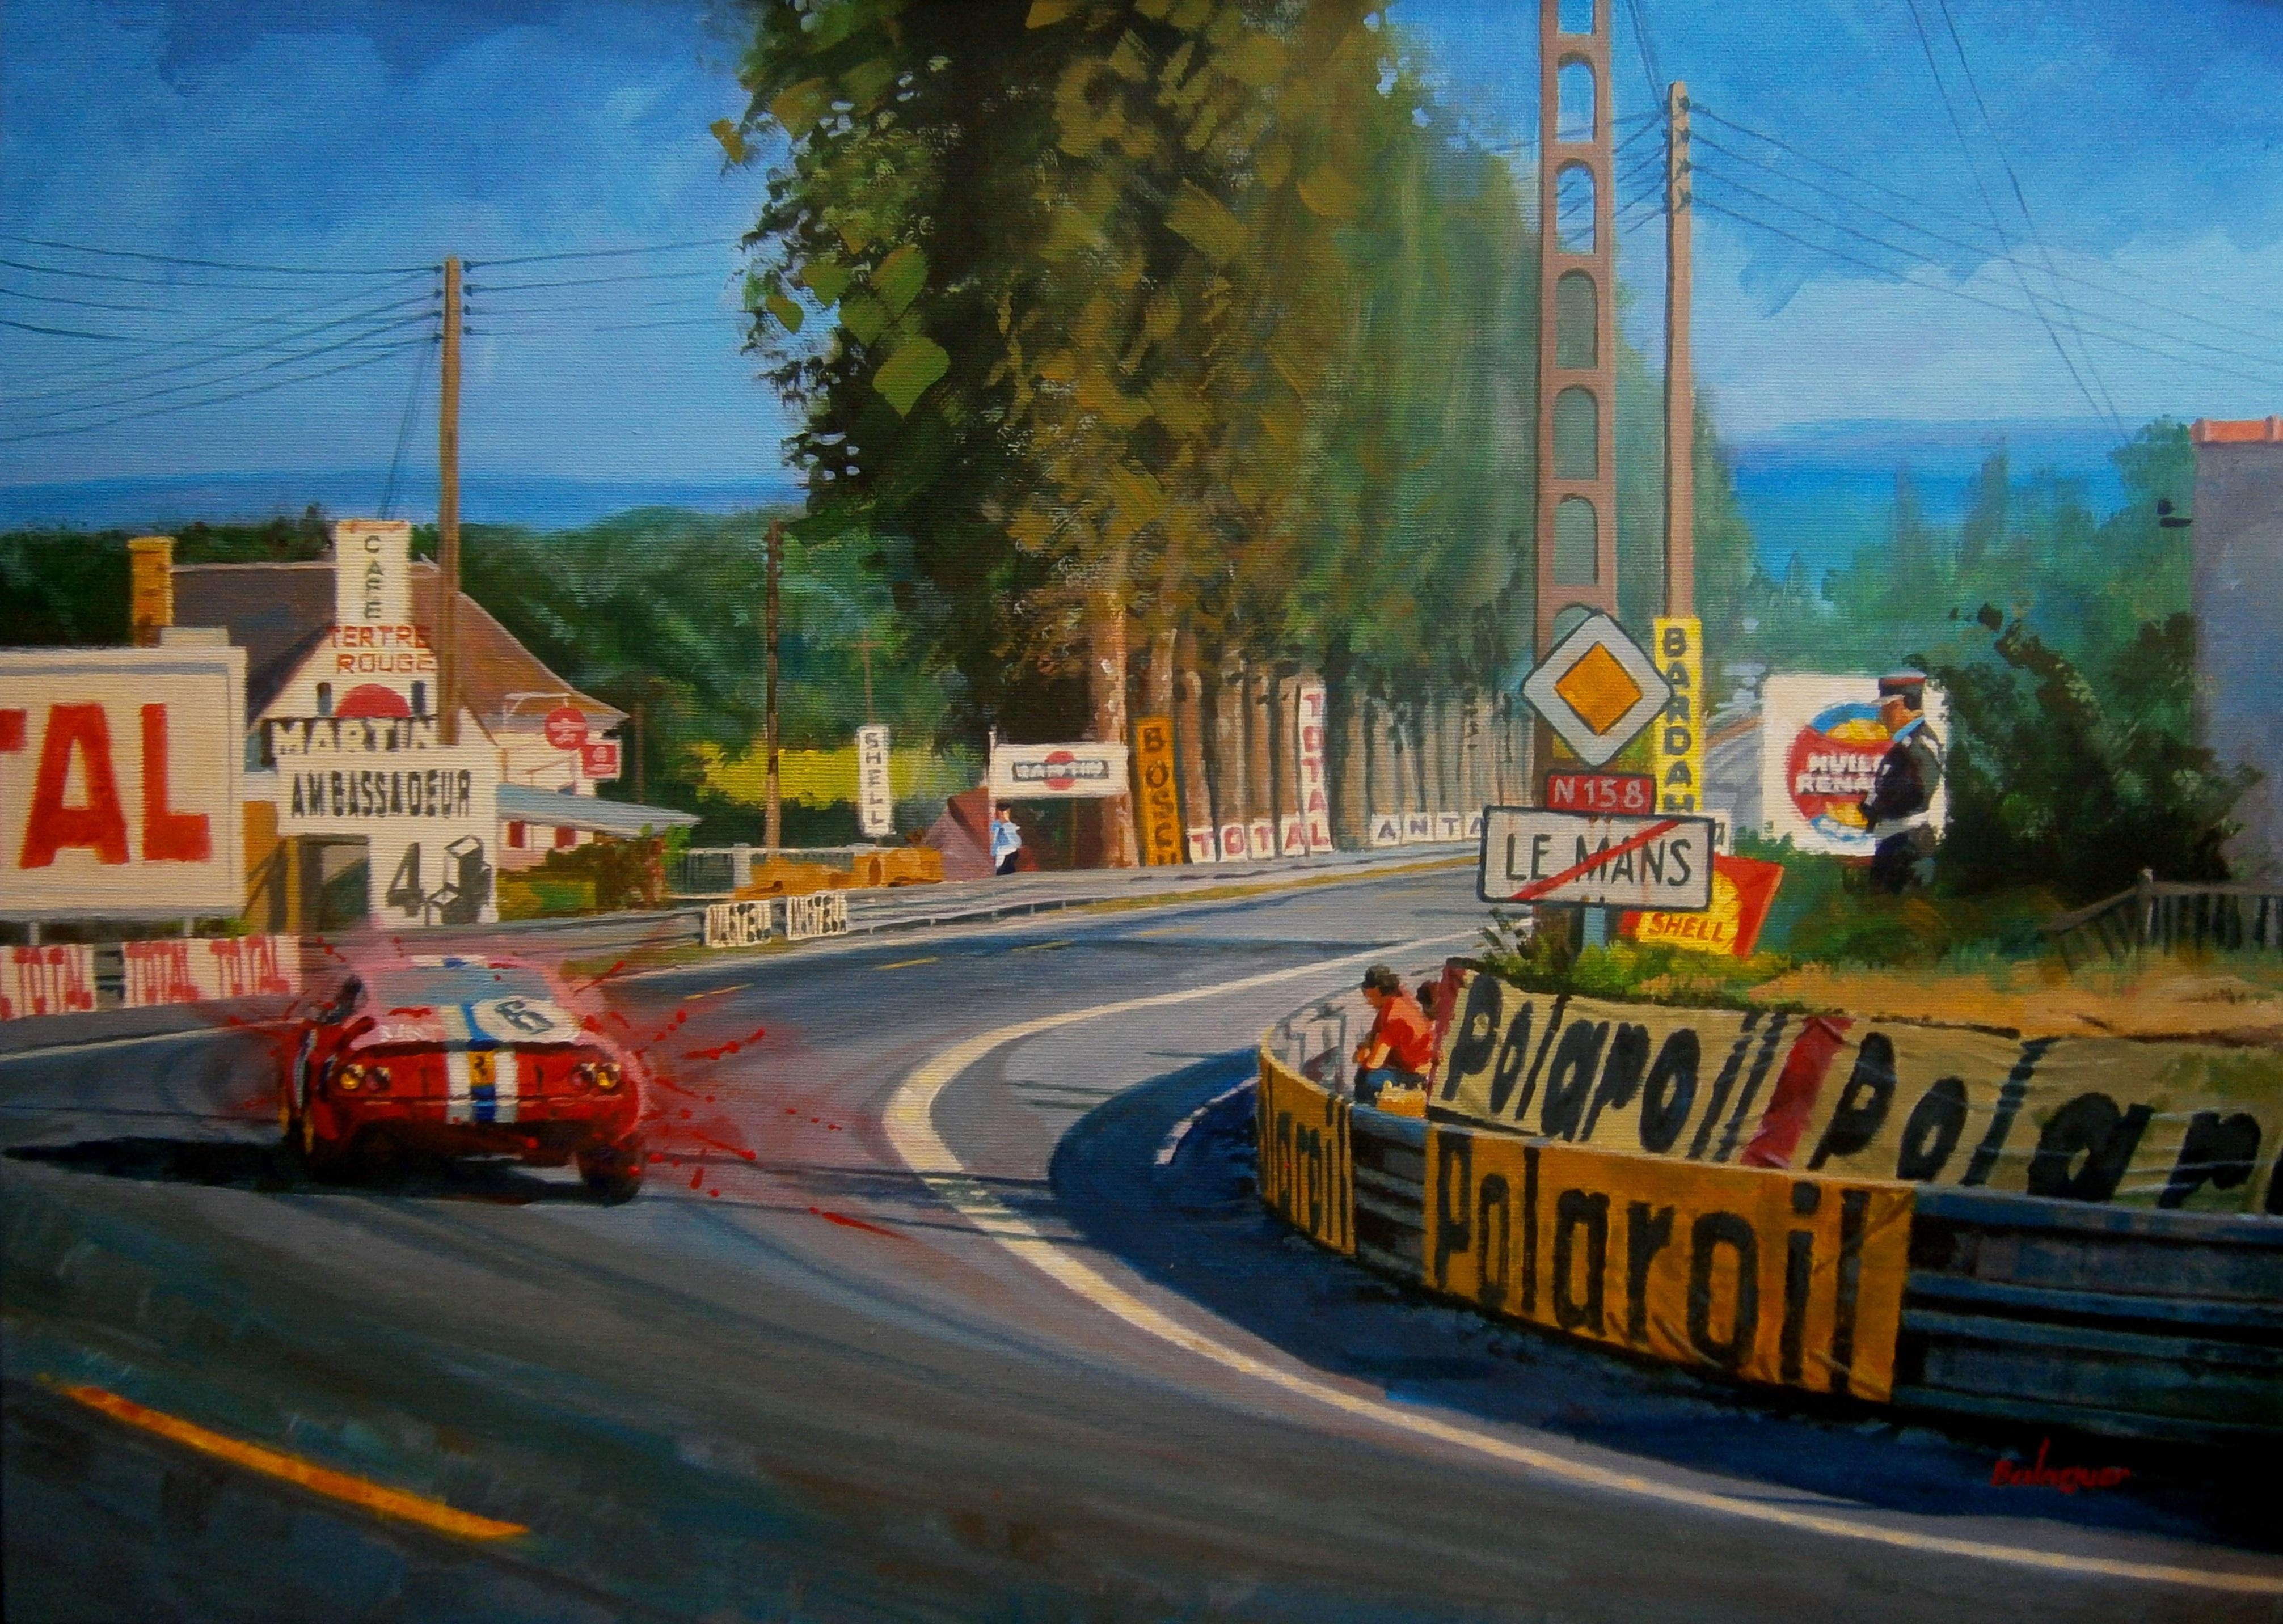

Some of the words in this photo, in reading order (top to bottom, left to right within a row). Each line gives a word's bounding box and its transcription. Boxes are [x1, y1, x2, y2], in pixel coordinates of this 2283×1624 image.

[291, 768, 471, 818] AMBASSADEUR
[1506, 834, 1551, 881] LE
[1575, 834, 1693, 887] MANS
[1648, 913, 1727, 944] SHELL
